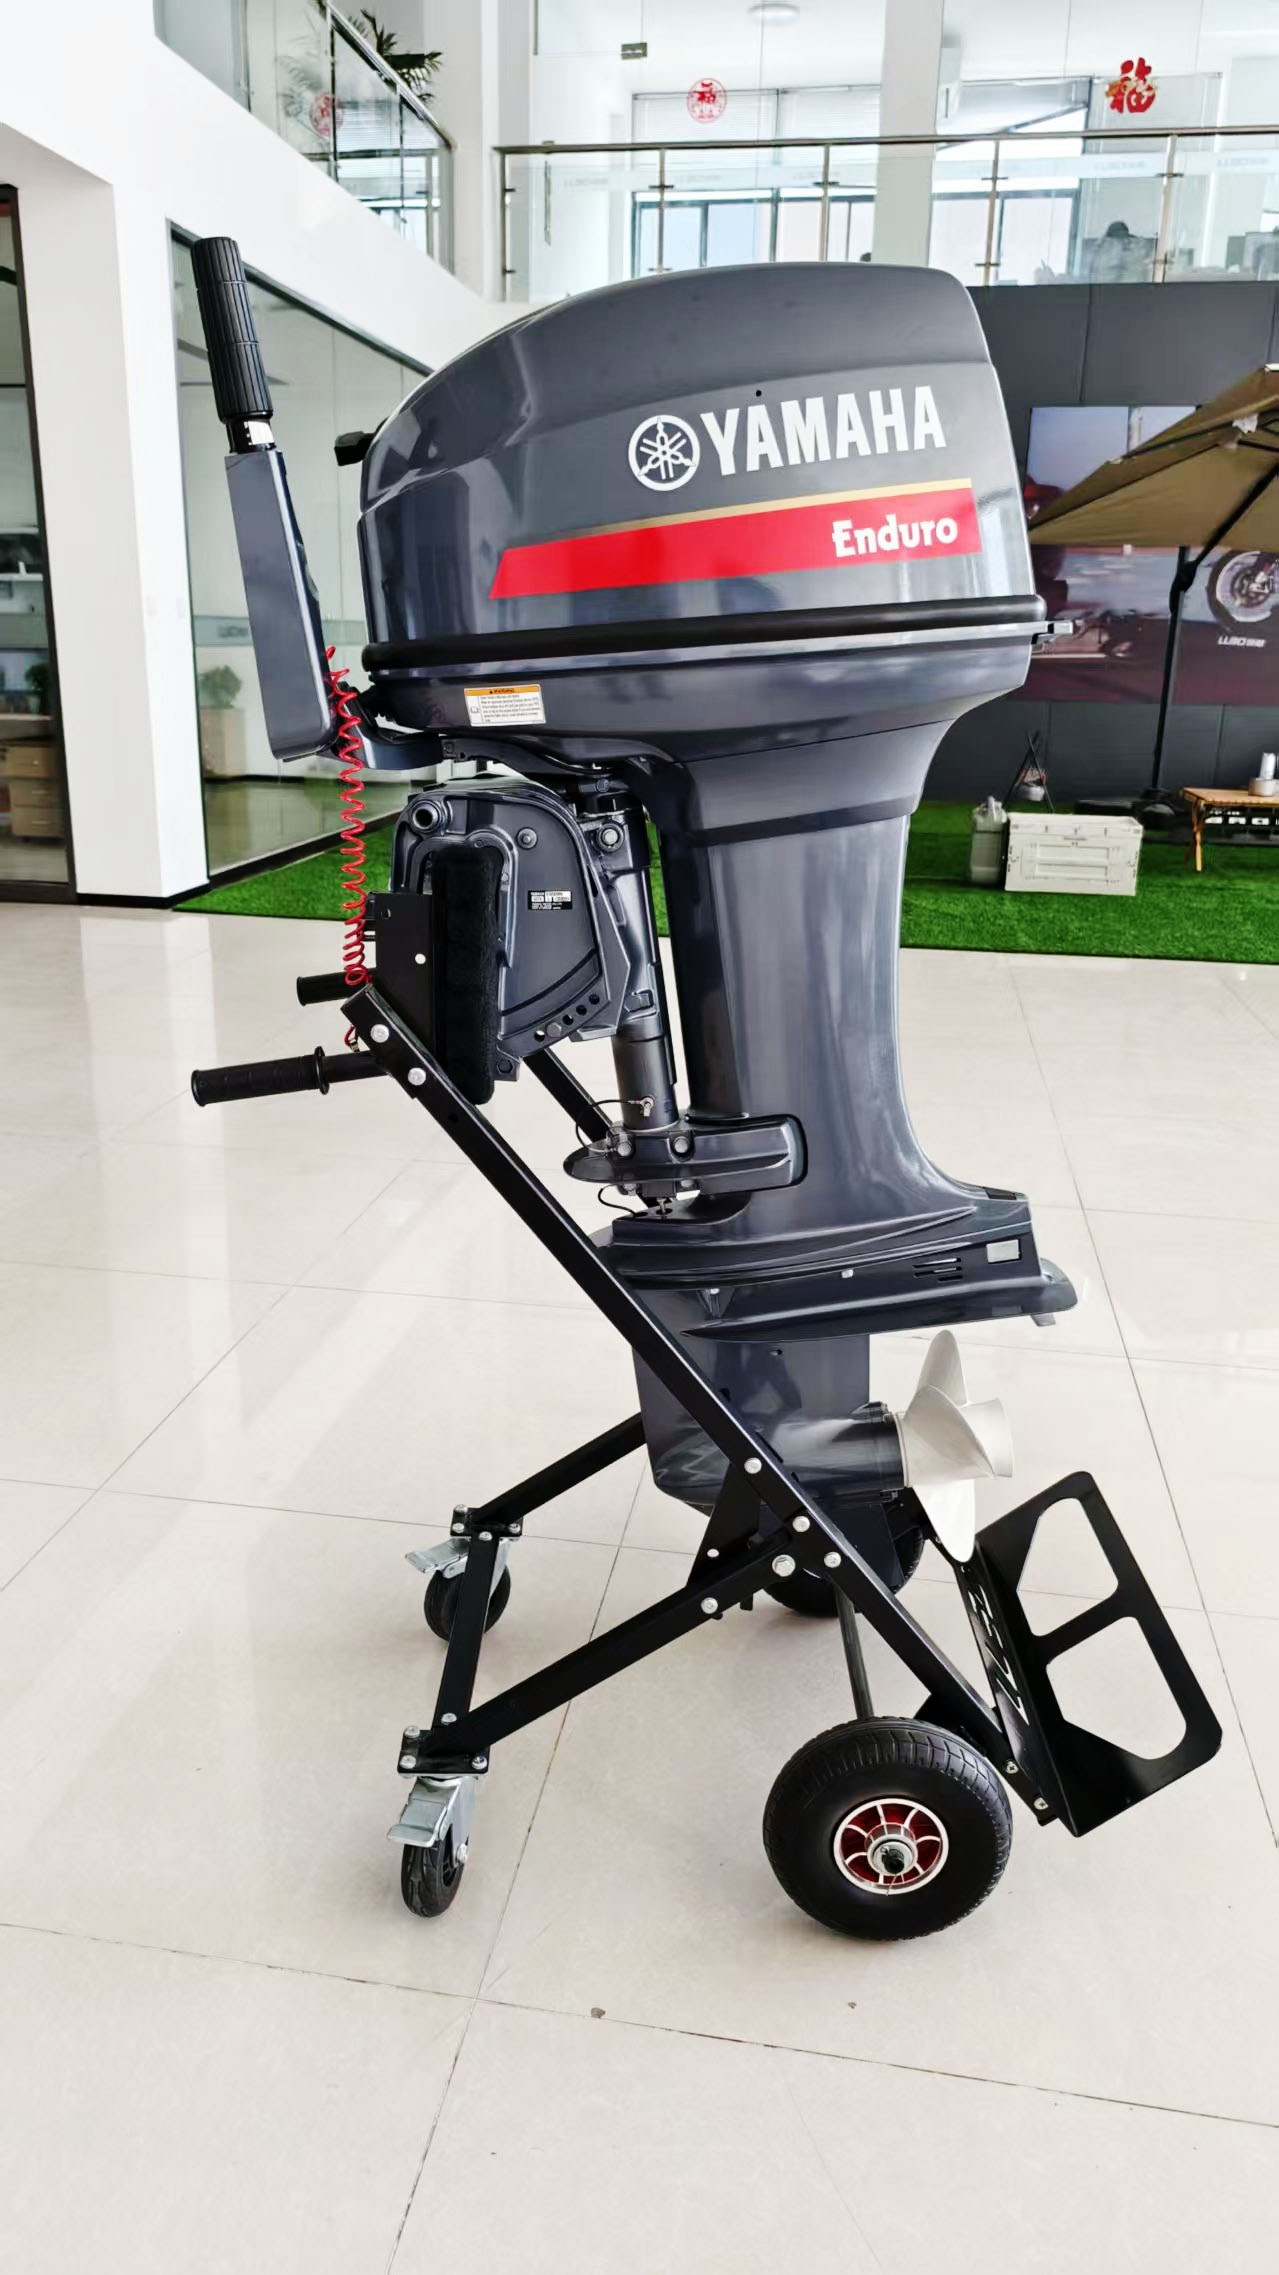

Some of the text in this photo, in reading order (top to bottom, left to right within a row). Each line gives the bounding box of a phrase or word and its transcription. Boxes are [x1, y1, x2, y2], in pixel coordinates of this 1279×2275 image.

[1107, 57, 1156, 113] 福
[700, 386, 946, 476] YAMAHA
[832, 514, 958, 558] Enduro
